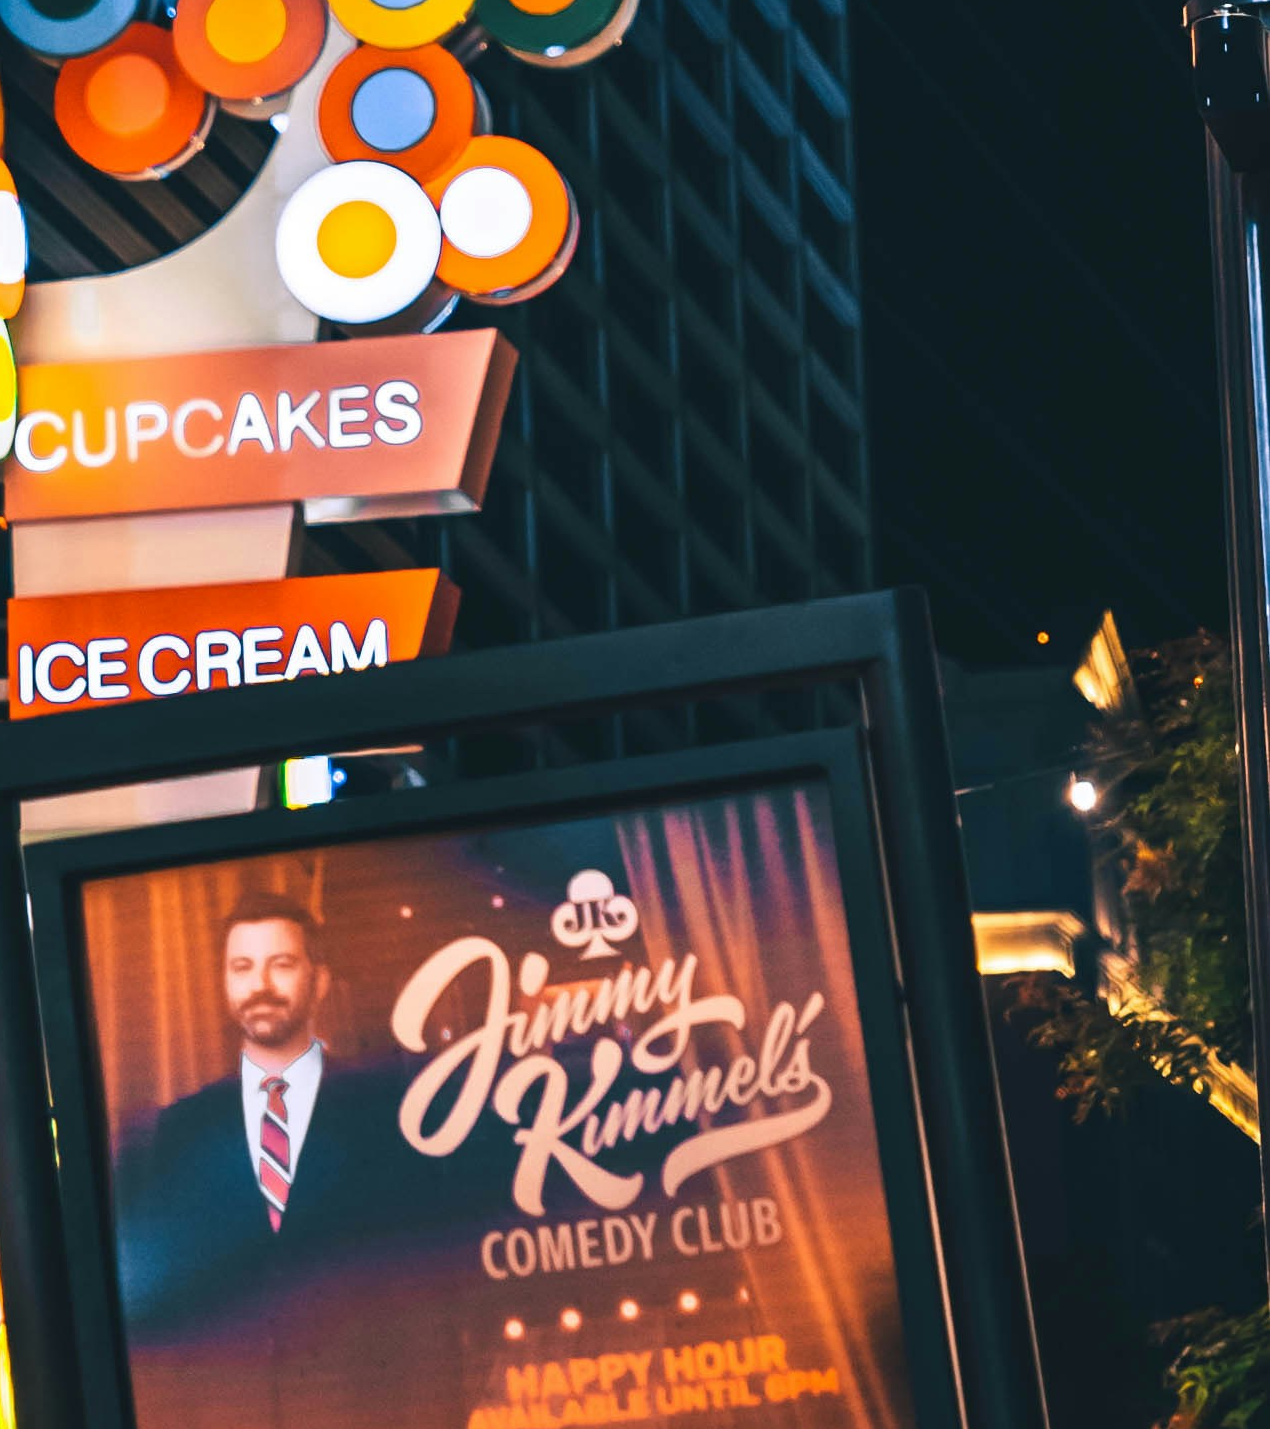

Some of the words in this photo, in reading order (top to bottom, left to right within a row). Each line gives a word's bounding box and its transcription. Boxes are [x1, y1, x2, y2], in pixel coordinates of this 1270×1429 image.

[14, 381, 422, 473] CUPCAKES
[18, 637, 130, 705] ICE
[138, 618, 389, 698] CREAM
[391, 936, 745, 1157] Jimmy
[493, 991, 833, 1217] Kimmel's
[481, 1211, 659, 1280] COMEDY
[670, 1196, 784, 1255] CLUB
[506, 1351, 653, 1402] HAPPY
[662, 1334, 788, 1383] HOUR
[655, 1377, 761, 1415] UNTIL
